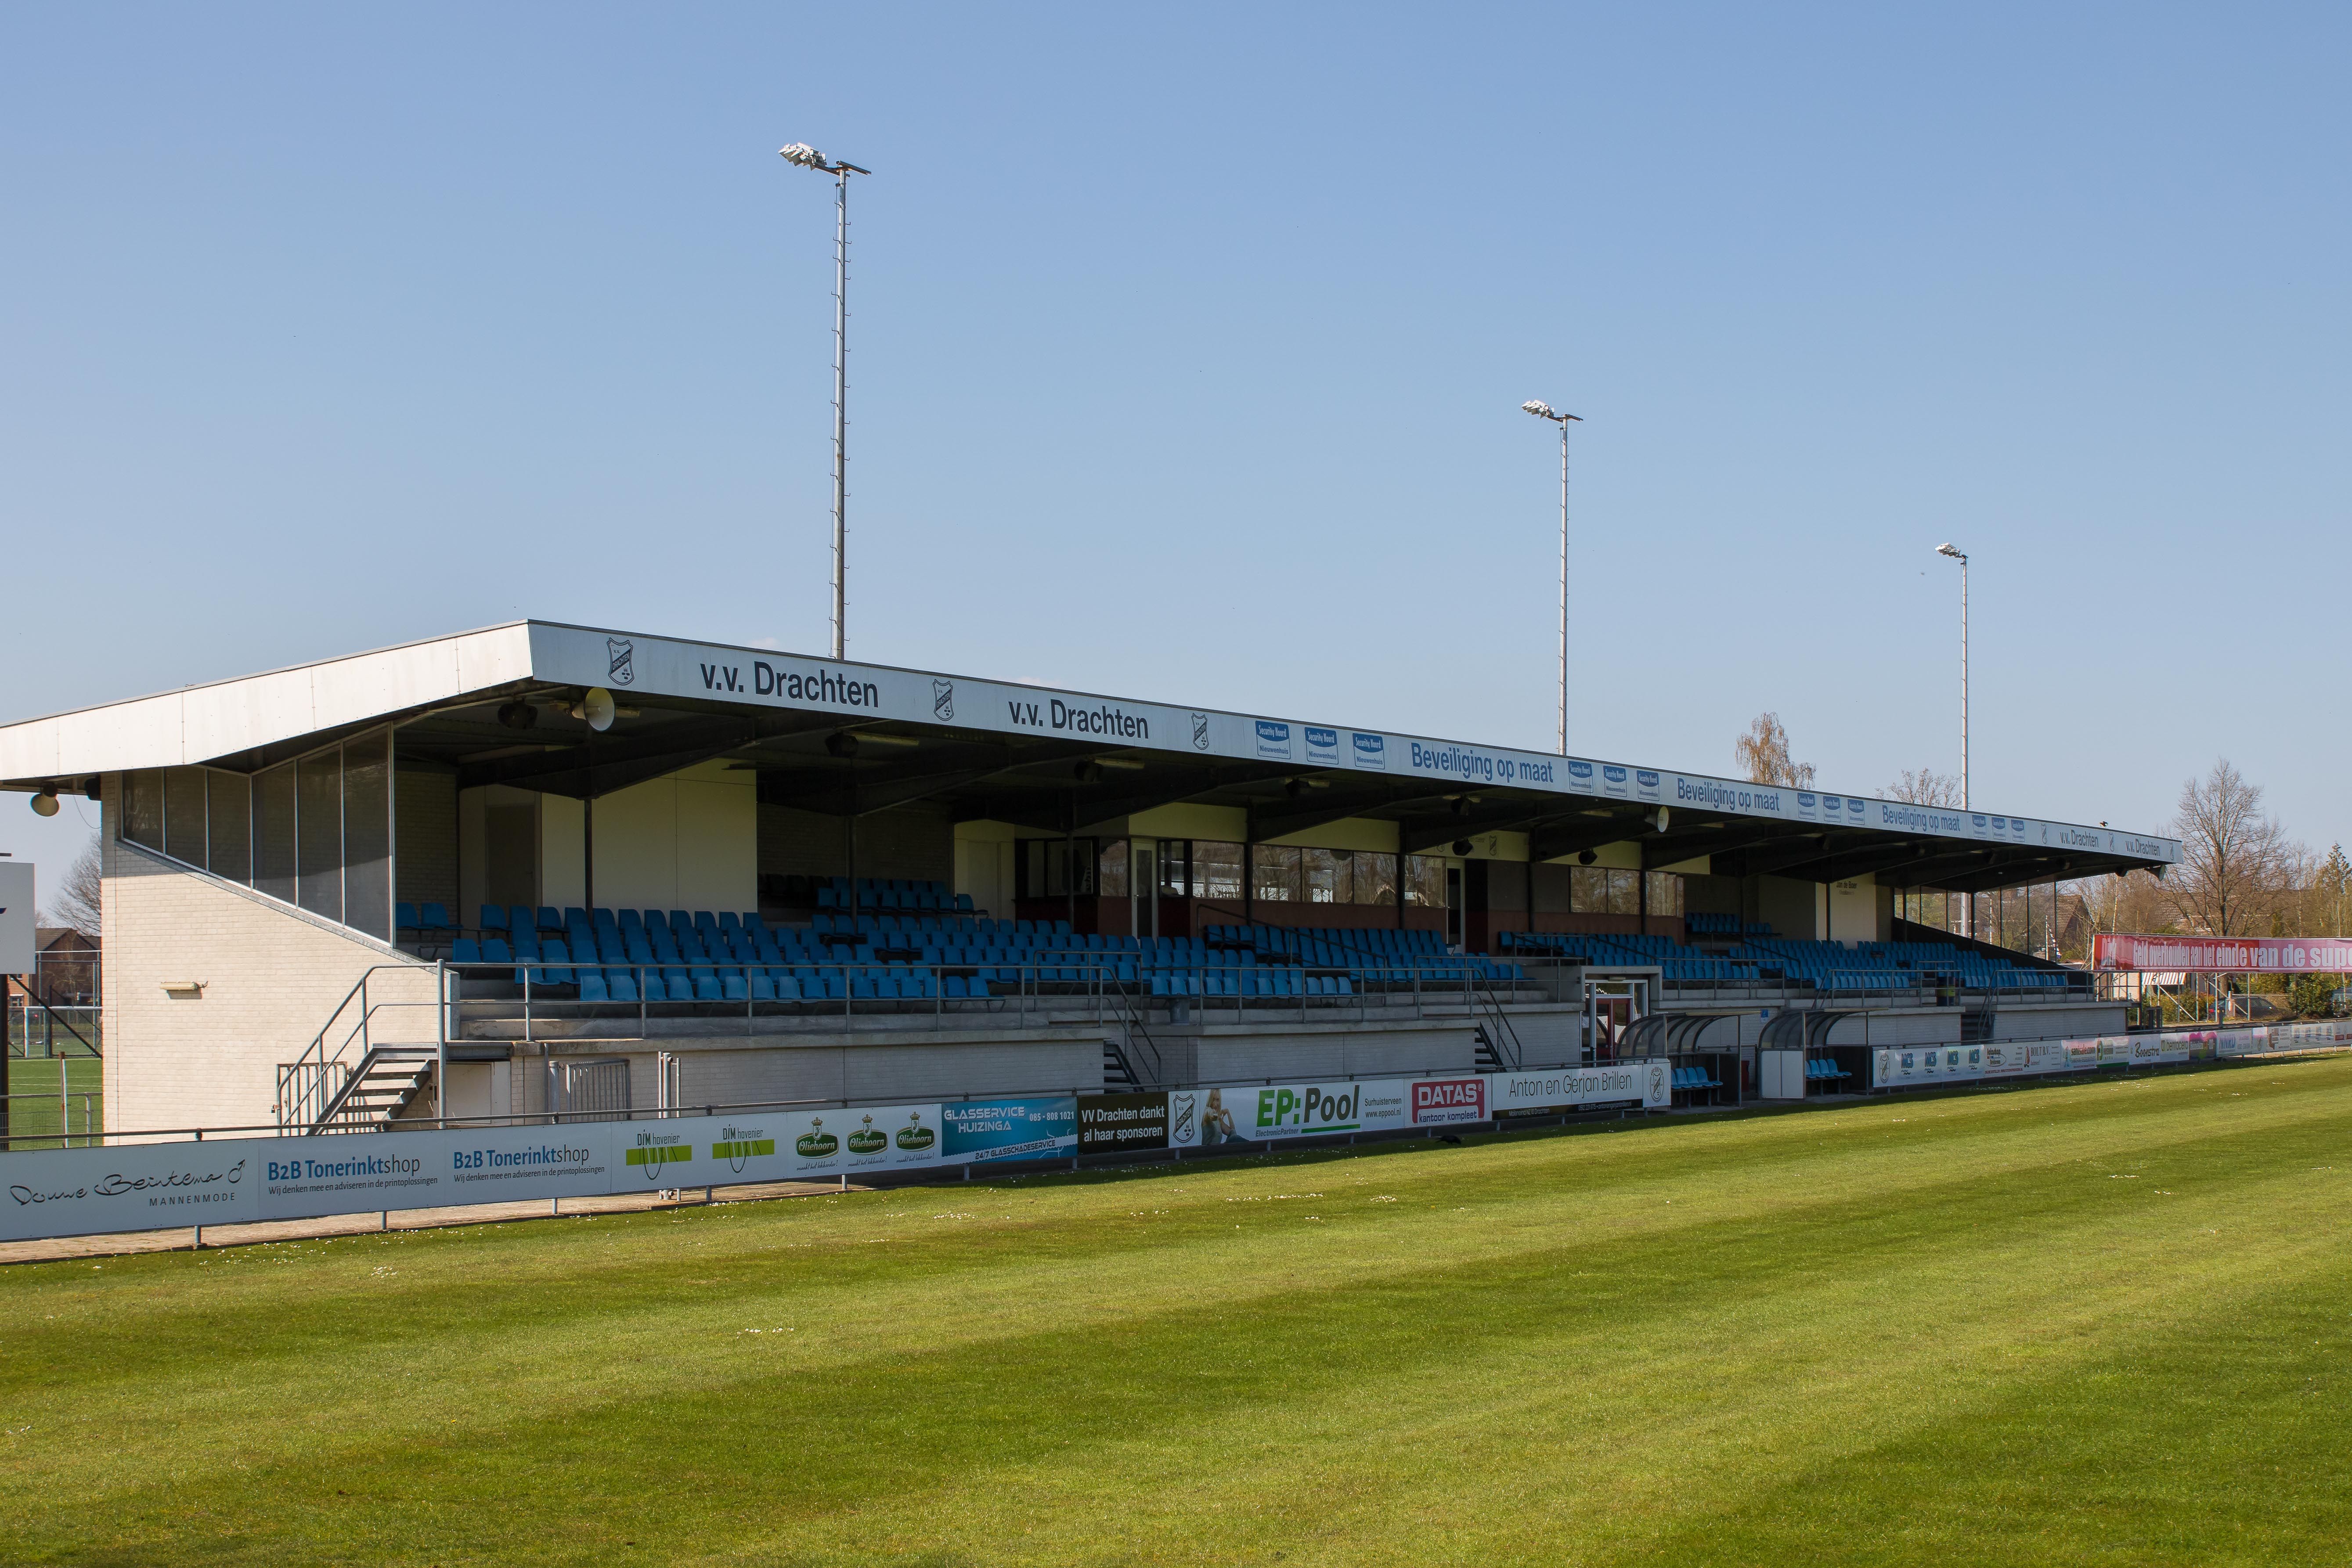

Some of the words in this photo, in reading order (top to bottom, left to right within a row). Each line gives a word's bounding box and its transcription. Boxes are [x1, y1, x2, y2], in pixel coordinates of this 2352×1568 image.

[700, 663, 744, 692] v.v.
[754, 661, 879, 708] Drachten
[1009, 701, 1043, 727] v.v.
[1050, 699, 1149, 739] Drachten
[1259, 725, 1274, 737] Security
[1275, 727, 1287, 737] Noord
[1308, 731, 1323, 743] Security
[1323, 733, 1335, 743] Noord
[1356, 737, 1370, 748] Security
[1371, 738, 1381, 749] Noord
[1259, 745, 1289, 755] Nieuwenhuis
[1309, 751, 1337, 760] Nieuwenhuis
[1356, 756, 1383, 765] Nieuwenhuis
[1411, 743, 1492, 782] Beveiliging
[1497, 759, 1514, 783] op
[1519, 761, 1554, 783] maat
[1677, 778, 1735, 811] Beveiliging
[1739, 791, 1750, 811] op
[1754, 793, 1779, 811] maat
[1882, 805, 1926, 832] Beveiliging
[1929, 815, 1939, 833] op
[1941, 815, 1960, 832] maat
[2060, 832, 2070, 845] v.v.
[2071, 829, 2099, 847] Drachten
[2125, 840, 2134, 852] v.v.
[2135, 838, 2161, 856] Drachten
[2133, 941, 2148, 966] Geld
[2149, 941, 2190, 966] overhouden
[2191, 946, 2202, 966] aan
[2204, 943, 2215, 966] het
[2216, 943, 2247, 966] einde
[2250, 947, 2278, 966] van
[2283, 944, 2305, 966] de
[2031, 1047, 2042, 1056] BOLT
[1509, 1078, 1542, 1097] Anton
[1546, 1079, 1559, 1094] en
[1563, 1073, 1598, 1098] Gerjan
[1602, 1071, 1631, 1090] Brillen
[1364, 1097, 1401, 1106] Surhuisterveen
[944, 1107, 1025, 1120] GLASSERVICE
[1047, 1112, 1058, 1121] 808
[1060, 1111, 1074, 1120] 1021
[1082, 1110, 1094, 1123] VV
[1097, 1108, 1137, 1122] Drachten
[1140, 1106, 1164, 1118] dankt
[1365, 1108, 1401, 1118] www.eppool.nl
[1419, 1114, 1445, 1123] kantoor
[1447, 1110, 1477, 1121] kompleet
[958, 1121, 1012, 1133] HUIZINGA
[1255, 1128, 1299, 1137] ElectronicPartner
[653, 1133, 680, 1145] hovenier
[738, 1128, 763, 1139] hovenier
[898, 1134, 931, 1144] Oliehoorn
[1084, 1129, 1092, 1142] al
[1095, 1128, 1115, 1141] haar
[1117, 1126, 1162, 1141] sponsoren
[799, 1141, 835, 1151] Oliehoorn
[850, 1137, 884, 1148] Oliehoorn
[975, 1151, 988, 1160] 24/7
[991, 1140, 1055, 1157] GLASSCHADESERVICE
[454, 1150, 483, 1169] B2B
[487, 1144, 589, 1165] Tonerinktshop
[867, 1156, 887, 1164] lekkerder!
[916, 1152, 934, 1161] lekkerder!
[268, 1161, 301, 1181] B2B
[305, 1154, 420, 1178] Tonerinktshop
[817, 1160, 837, 1168] lekkerder!
[454, 1174, 465, 1183] Wij
[466, 1172, 489, 1181] denken
[512, 1169, 541, 1178] adviseren
[549, 1168, 556, 1176] de
[557, 1166, 605, 1177] printoplossingen
[268, 1186, 281, 1196] Wij
[282, 1185, 307, 1194] denken
[335, 1181, 366, 1190] adviseren
[385, 1177, 437, 1189] printoplossingen
[149, 1192, 236, 1207] MANNENMODE
